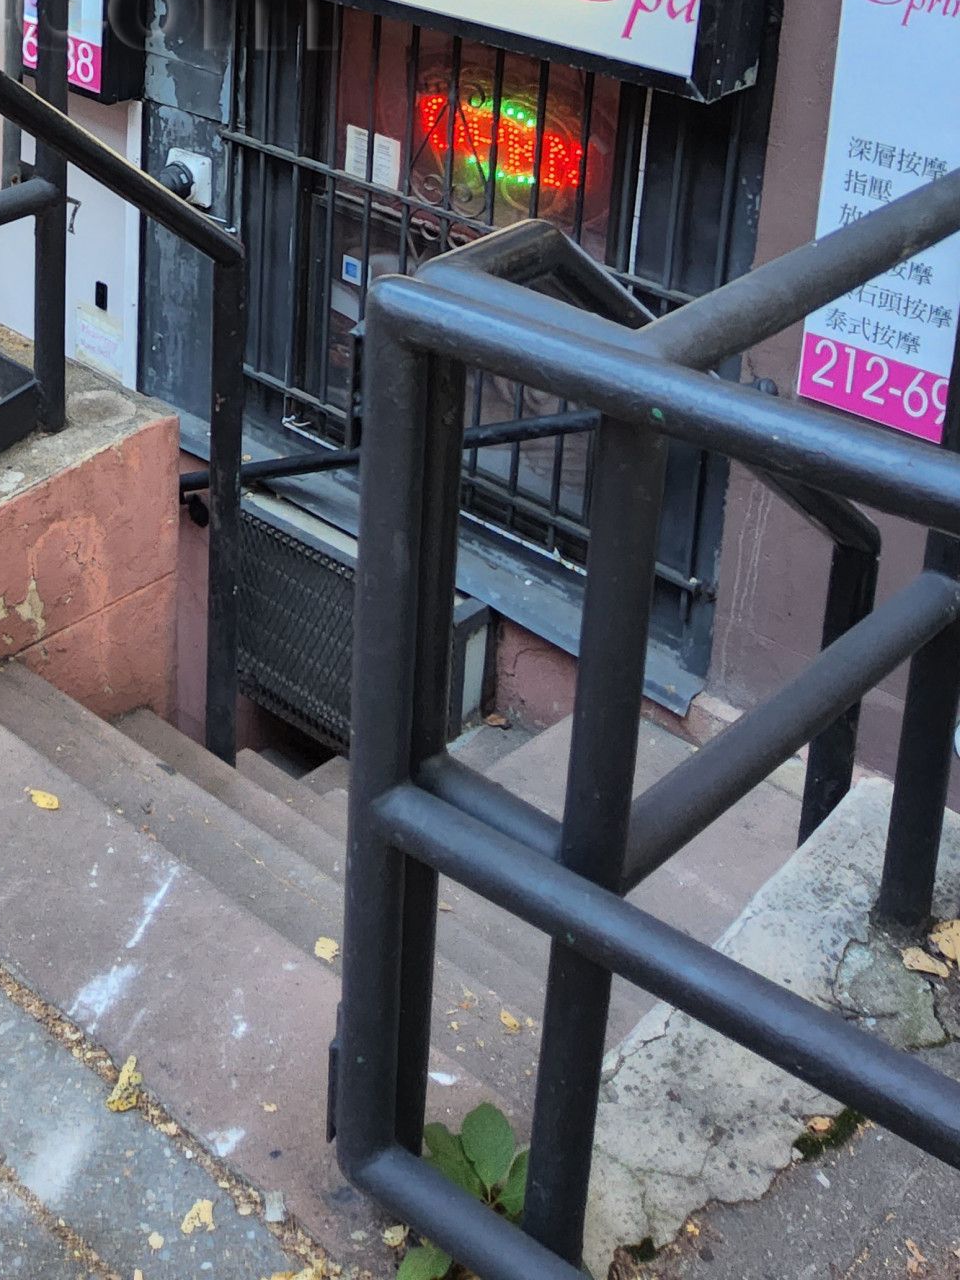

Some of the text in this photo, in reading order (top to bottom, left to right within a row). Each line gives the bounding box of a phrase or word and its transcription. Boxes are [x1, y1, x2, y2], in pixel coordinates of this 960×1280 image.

[847, 134, 949, 181] 深層按摩
[825, 307, 922, 356] 泰式按摩
